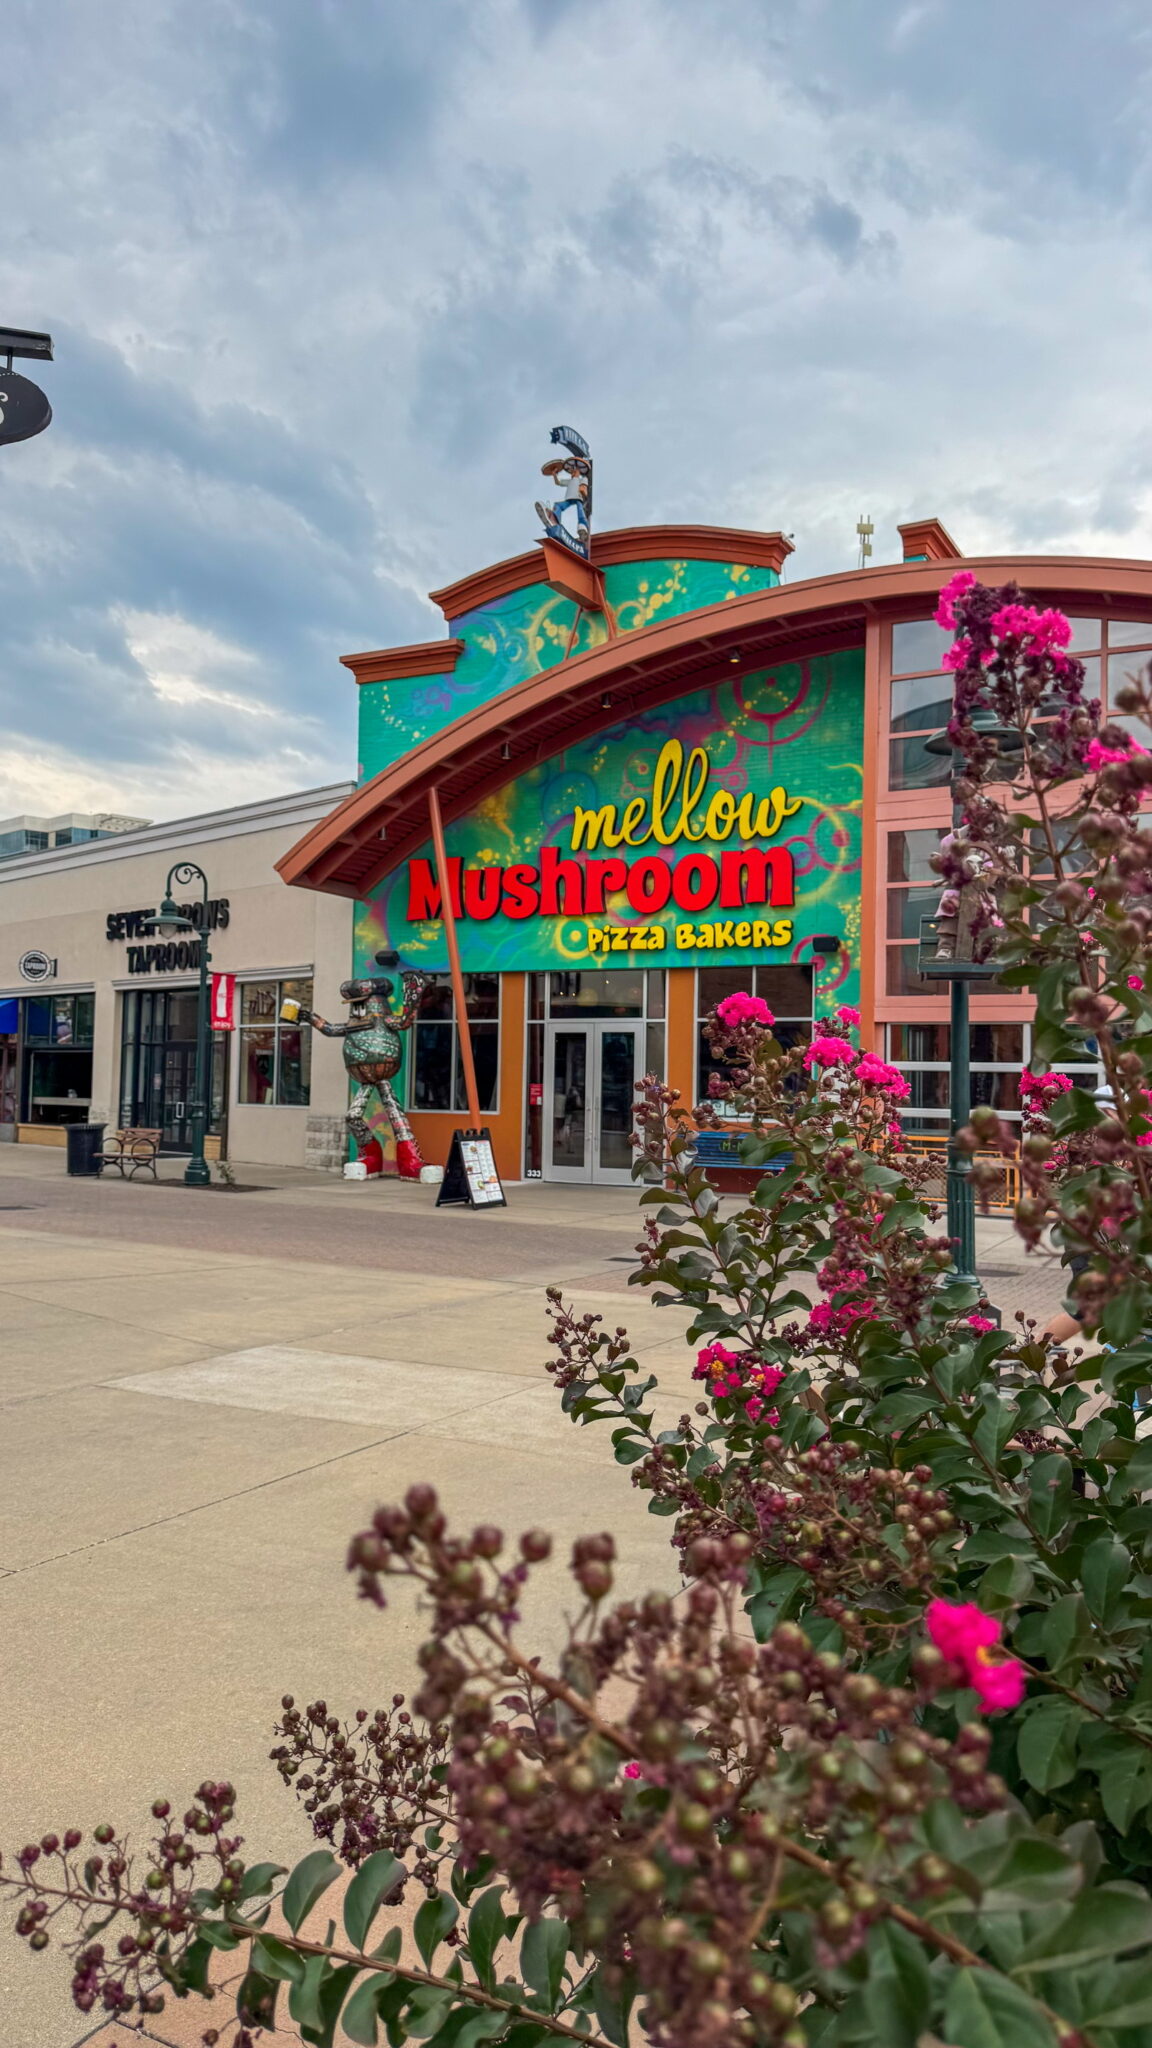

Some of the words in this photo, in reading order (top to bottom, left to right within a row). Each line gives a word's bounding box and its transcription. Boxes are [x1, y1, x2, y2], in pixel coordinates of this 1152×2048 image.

[571, 738, 803, 851] mellow
[407, 846, 794, 922] Mushroom
[106, 909, 156, 940] SEVEN
[127, 940, 201, 973] TAPROOM
[527, 1169, 541, 1178] 333
